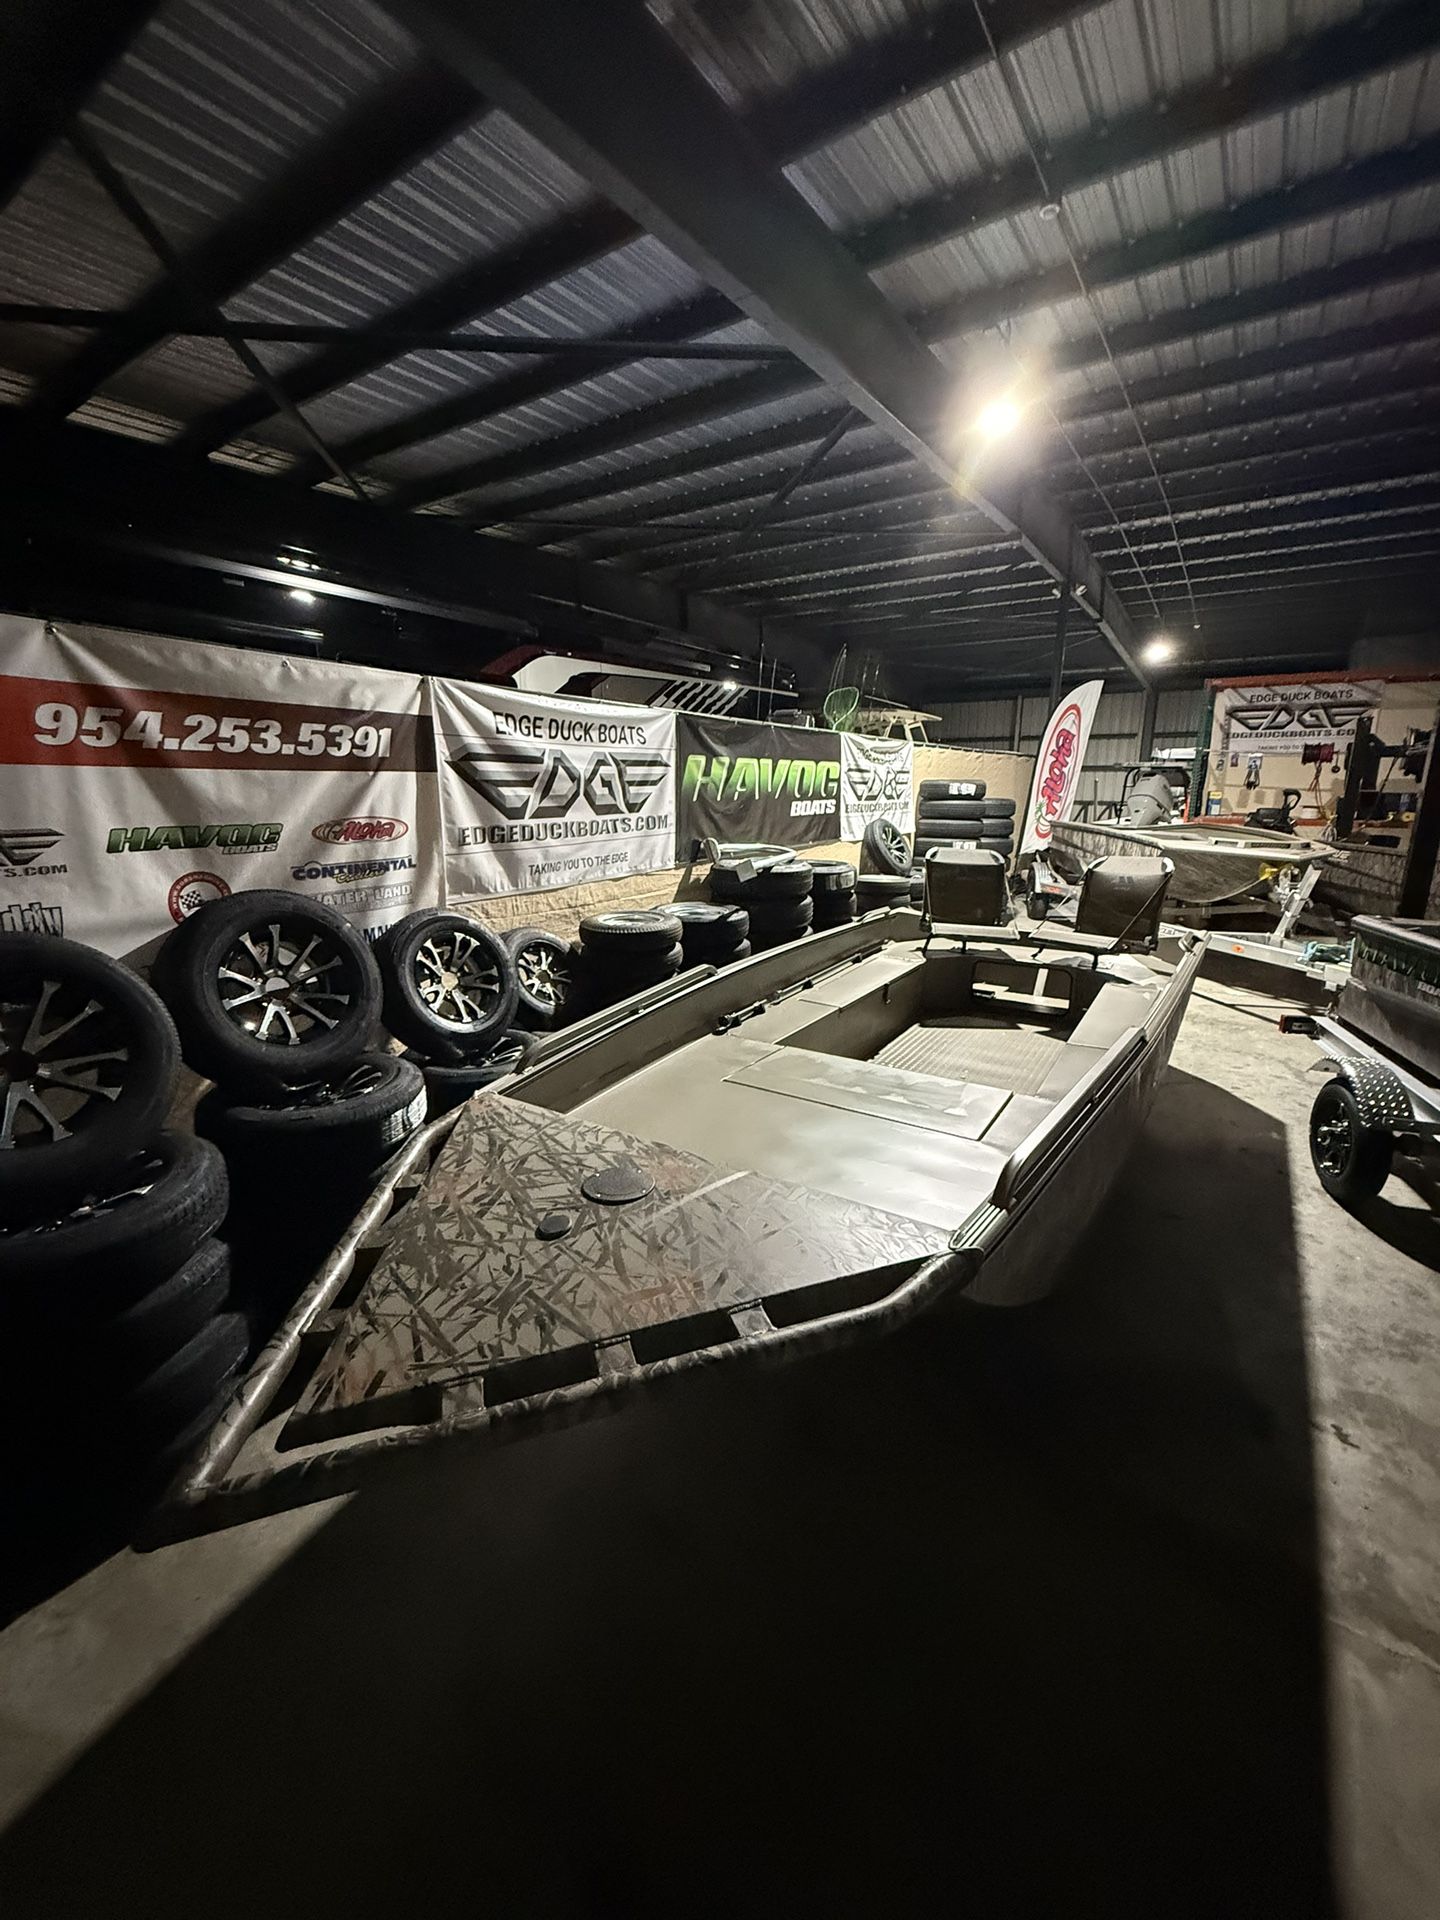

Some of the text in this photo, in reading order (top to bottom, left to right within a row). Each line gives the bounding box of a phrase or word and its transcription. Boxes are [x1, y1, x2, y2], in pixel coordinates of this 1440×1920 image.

[1250, 689, 1353, 704] EDGE DUCK BOATS
[34, 702, 393, 758] 954.253.5391
[493, 711, 647, 745] EDGE DUCK BOATS
[1226, 728, 1355, 740] EDGEDUCKBOATS.CO
[443, 742, 671, 821] EDGE
[680, 754, 841, 803] HAVOC
[789, 799, 837, 817] BOATS
[106, 823, 284, 854] HAVOC
[458, 814, 669, 848] EDGEDUCKBOATS.COM
[222, 842, 279, 856] BOATS
[0, 863, 68, 878] S.COM
[291, 857, 417, 881] CONTINENTAL
[528, 852, 629, 877] TAKING YOU TO THE EDGE
[374, 884, 412, 902] LAND
[1417, 980, 1440, 998] BOA
